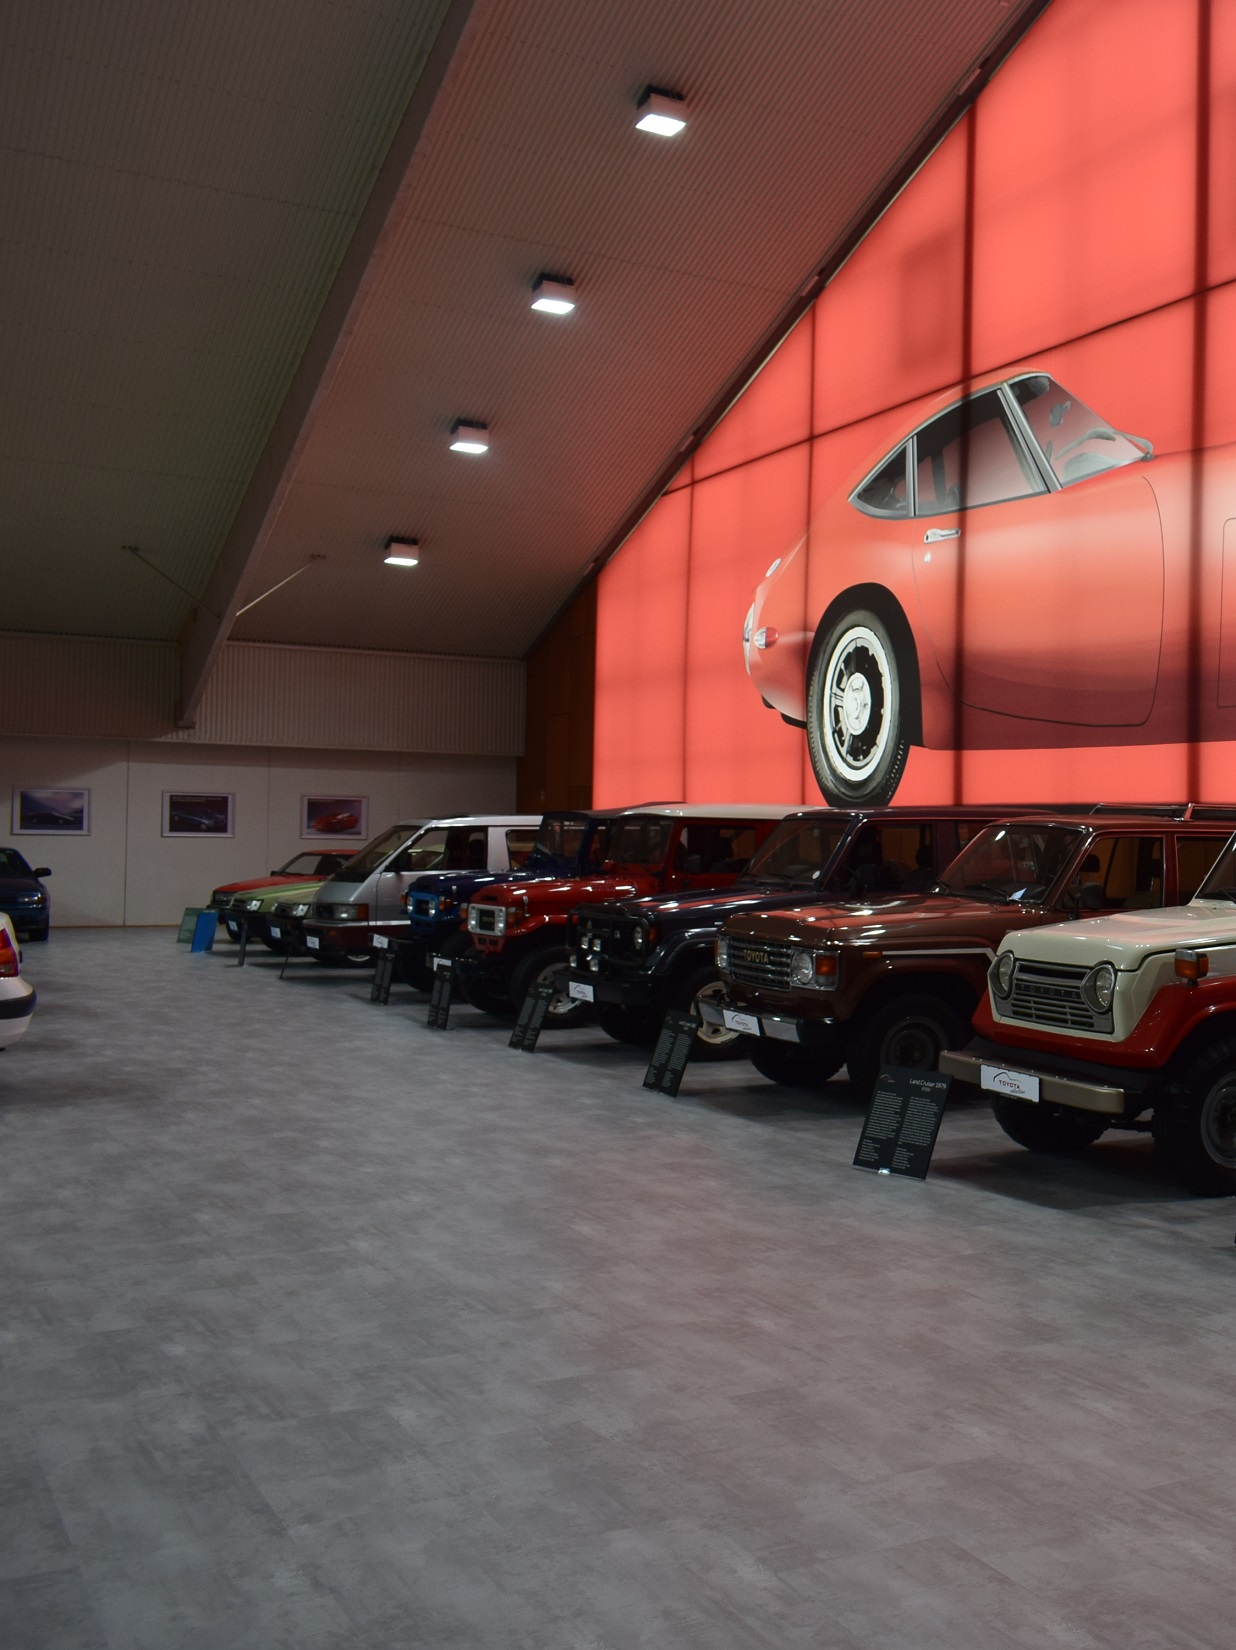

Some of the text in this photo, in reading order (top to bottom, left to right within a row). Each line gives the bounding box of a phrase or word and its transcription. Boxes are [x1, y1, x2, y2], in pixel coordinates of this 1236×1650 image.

[744, 949, 769, 963] TOYOTA
[1021, 984, 1077, 998] TOYOTA
[920, 1079, 936, 1088] Cruiser
[999, 1079, 1021, 1089] TOYOTA
